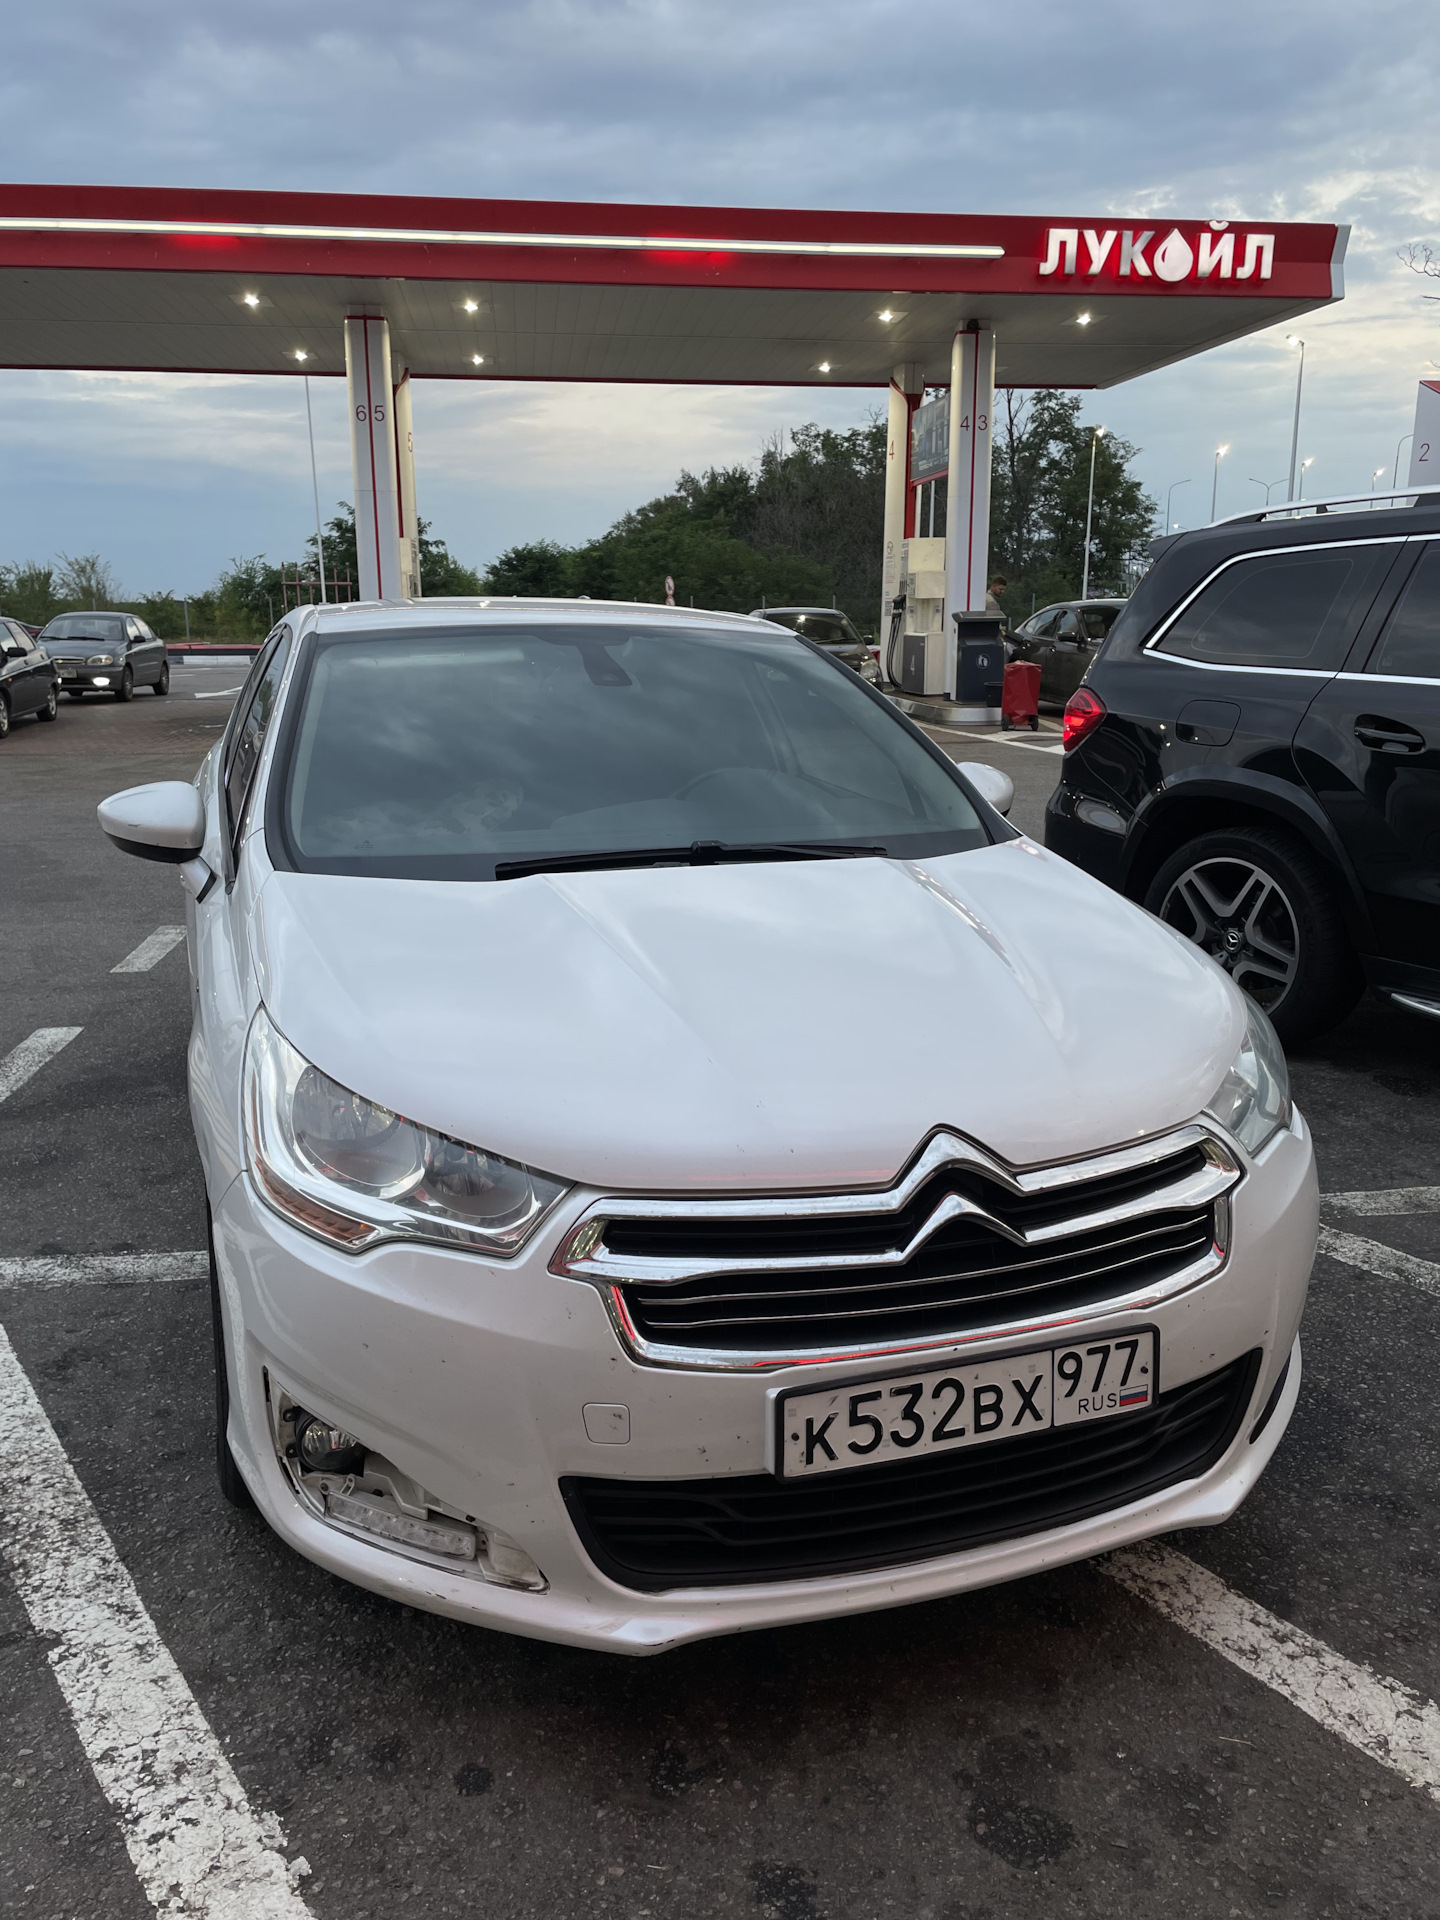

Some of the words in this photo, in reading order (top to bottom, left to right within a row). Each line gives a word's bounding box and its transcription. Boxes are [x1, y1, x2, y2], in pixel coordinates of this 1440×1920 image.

[355, 404, 367, 422] 6
[374, 404, 385, 422] 5
[960, 415, 970, 431] 4
[977, 415, 988, 431] 3
[888, 440, 895, 460] 4
[1418, 443, 1430, 462] 2
[1057, 1338, 1139, 1398] 977
[1078, 1392, 1117, 1415] RUS
